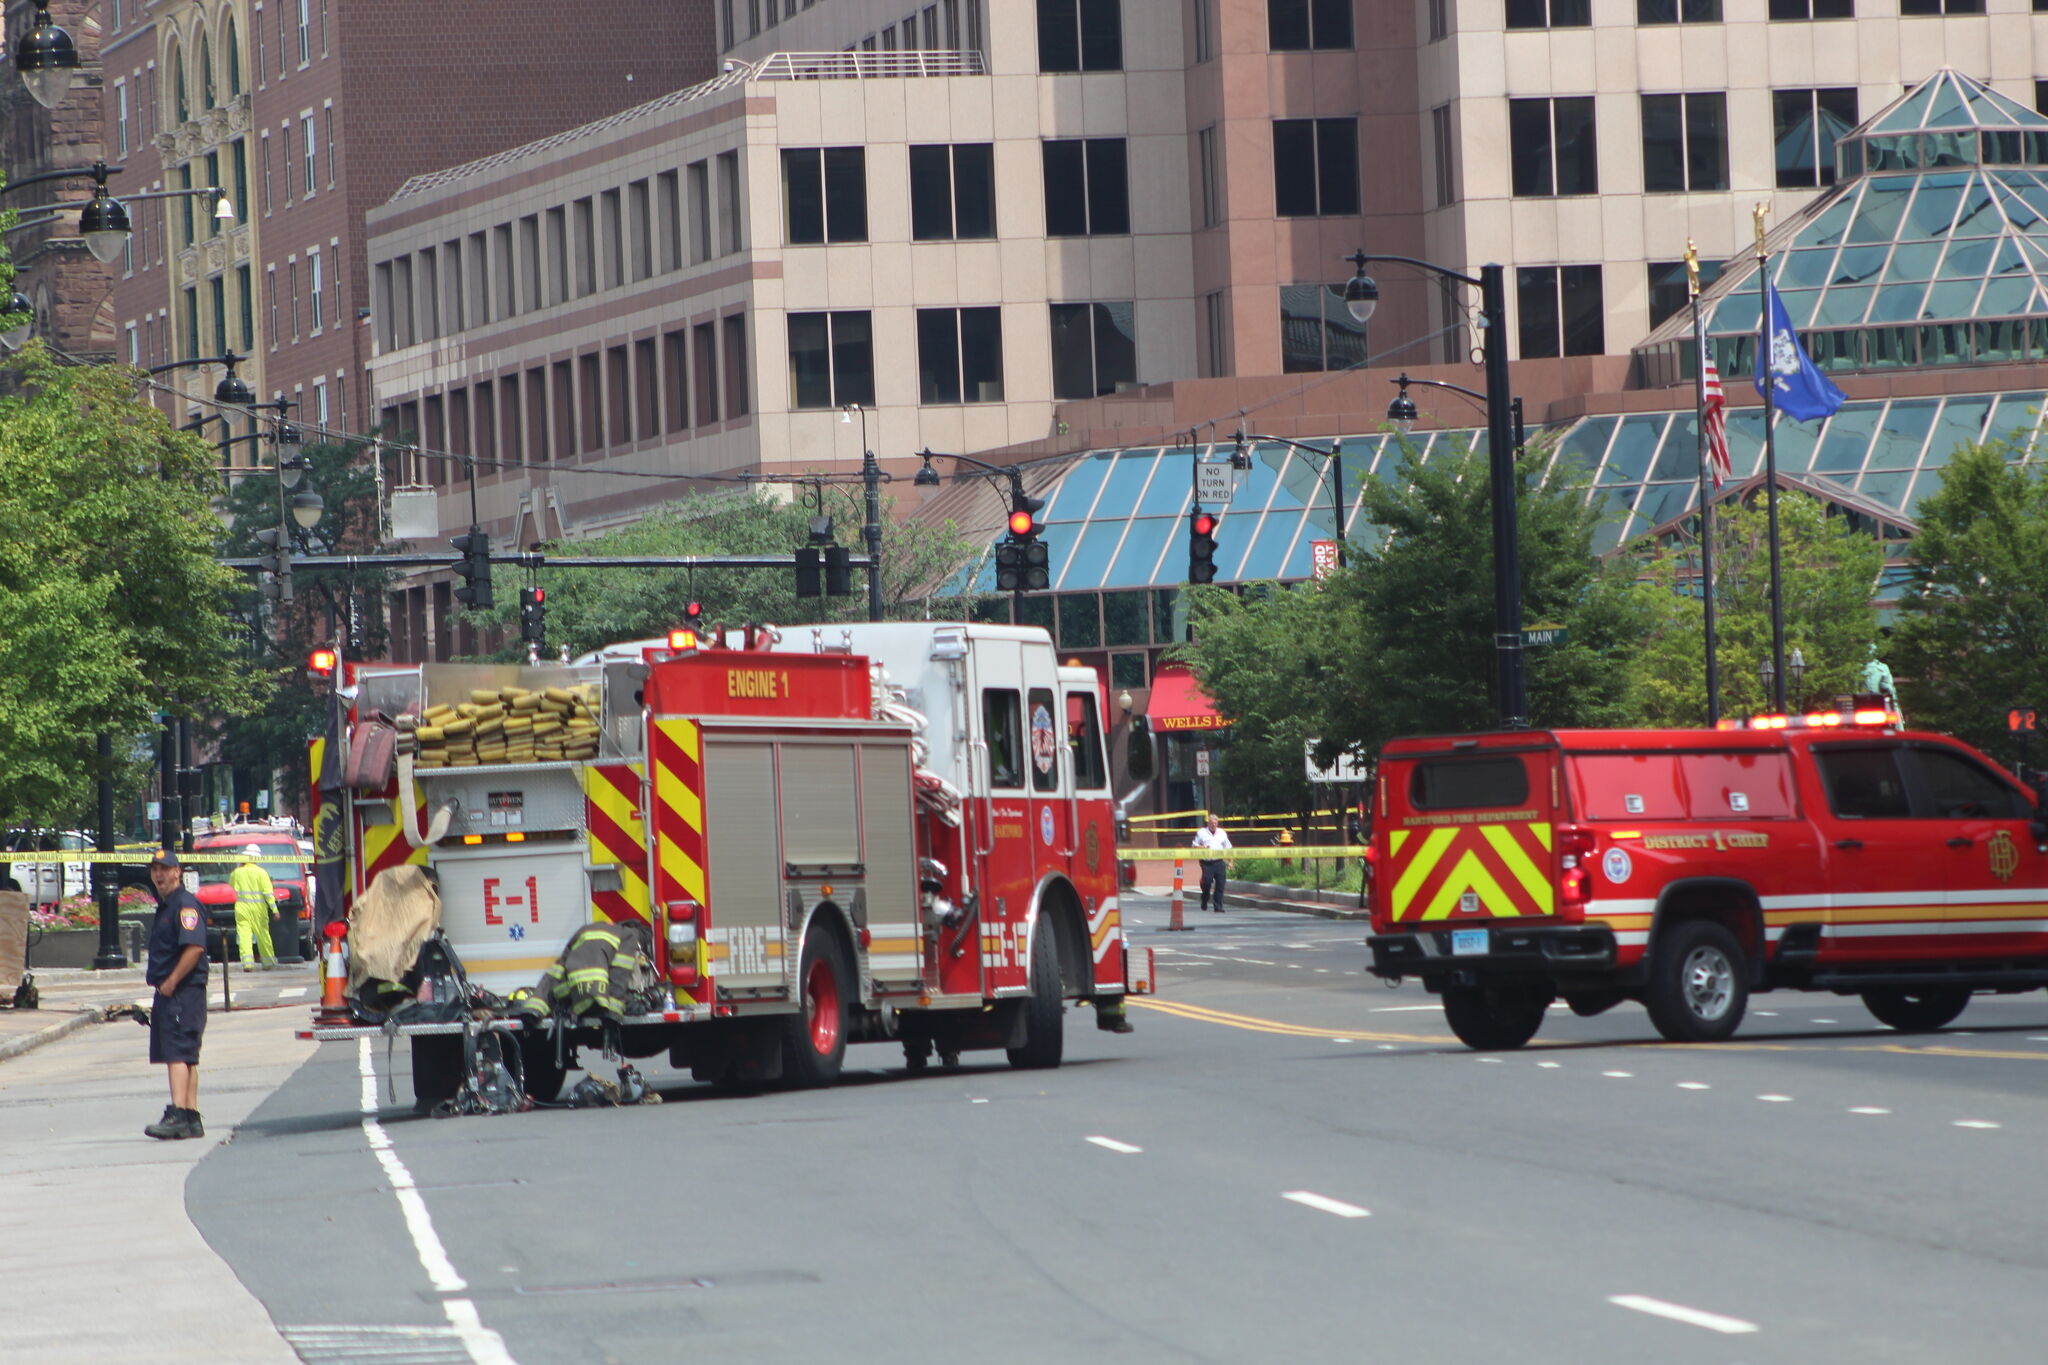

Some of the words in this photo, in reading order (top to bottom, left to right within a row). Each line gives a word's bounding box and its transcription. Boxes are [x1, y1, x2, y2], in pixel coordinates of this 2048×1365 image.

[1206, 467, 1220, 476] NO
[1202, 478, 1225, 487] TURN
[1196, 490, 1208, 498] ON
[1213, 490, 1230, 499] RED
[1528, 630, 1552, 644] MAIN
[728, 669, 777, 698] ENGINE
[781, 671, 789, 699] 1
[1162, 715, 1212, 729] WELLS
[1644, 834, 1710, 849] DISTRICT
[1712, 829, 1728, 851] 1
[1727, 832, 1769, 848] CHIEF
[483, 876, 539, 925] E-1
[729, 926, 768, 975] FIRE
